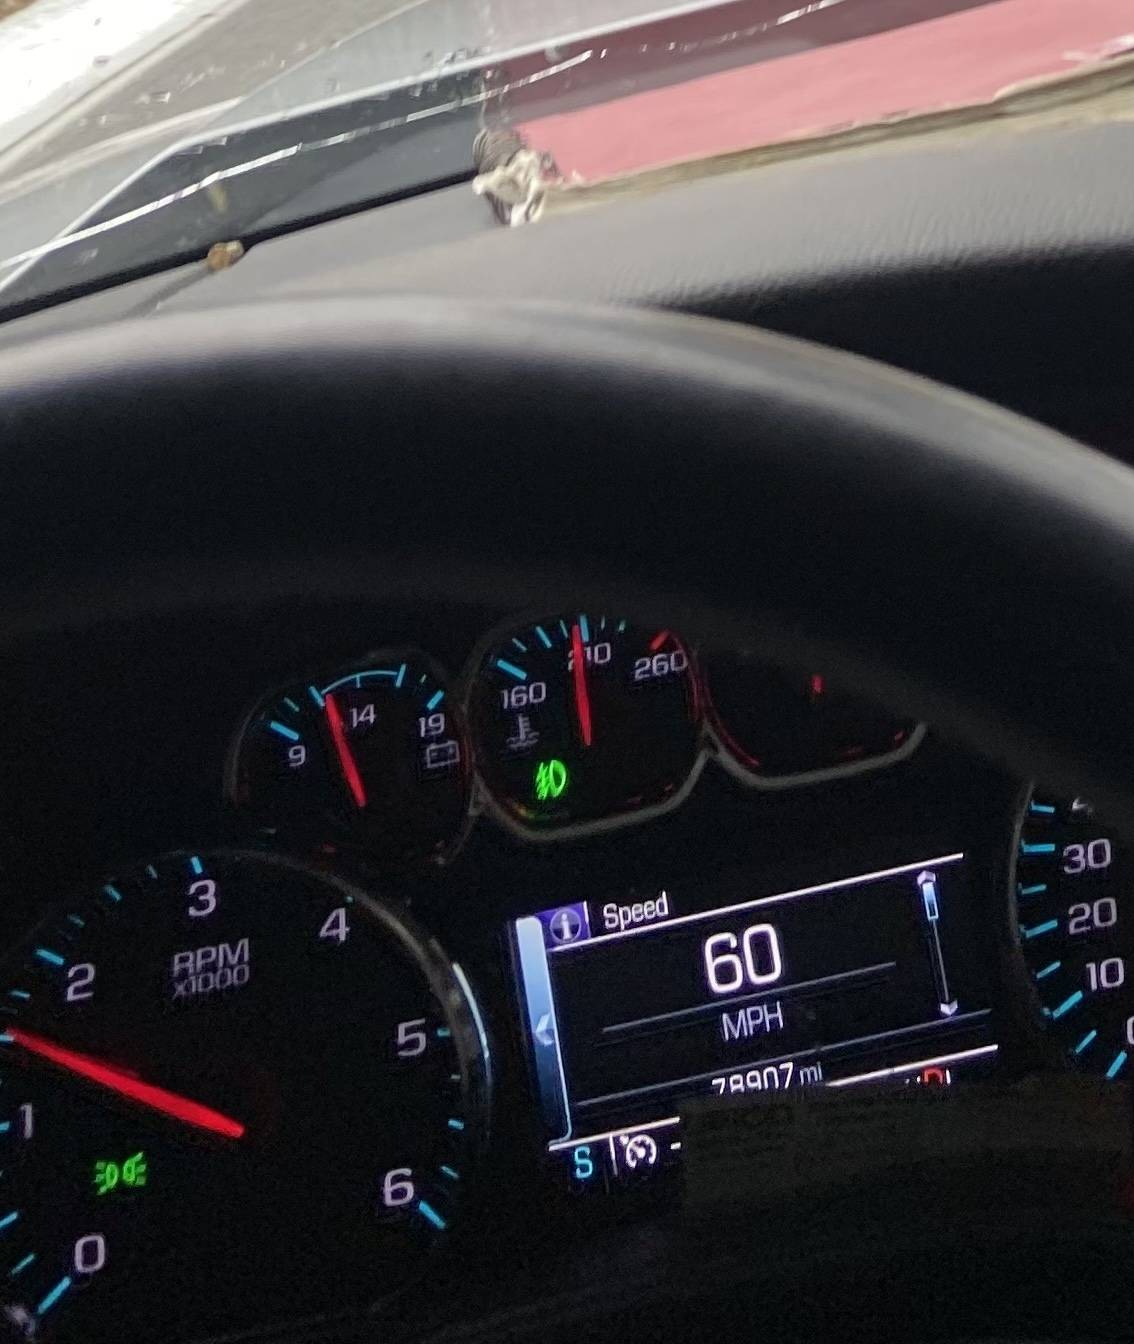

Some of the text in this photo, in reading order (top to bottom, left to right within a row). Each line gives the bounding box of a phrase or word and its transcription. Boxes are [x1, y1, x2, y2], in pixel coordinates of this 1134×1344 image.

[635, 650, 688, 681] 260
[501, 680, 547, 709] 160
[349, 703, 376, 727] 14
[418, 713, 445, 737] 19
[288, 745, 306, 767] 9
[1063, 838, 1112, 874] 30
[187, 878, 217, 917] 3
[603, 891, 670, 930] Speed
[1067, 897, 1117, 933] 20
[319, 907, 350, 943] 4
[173, 938, 249, 977] RPM
[704, 923, 782, 994] 60
[1084, 958, 1125, 991] 10
[65, 963, 97, 1002] 2
[397, 1019, 427, 1057] 5
[721, 1001, 784, 1041] MPH
[800, 1062, 822, 1086] mi
[19, 1103, 33, 1140] 1
[574, 1145, 593, 1179] S
[383, 1167, 415, 1206] 6
[74, 1234, 106, 1273] 0
